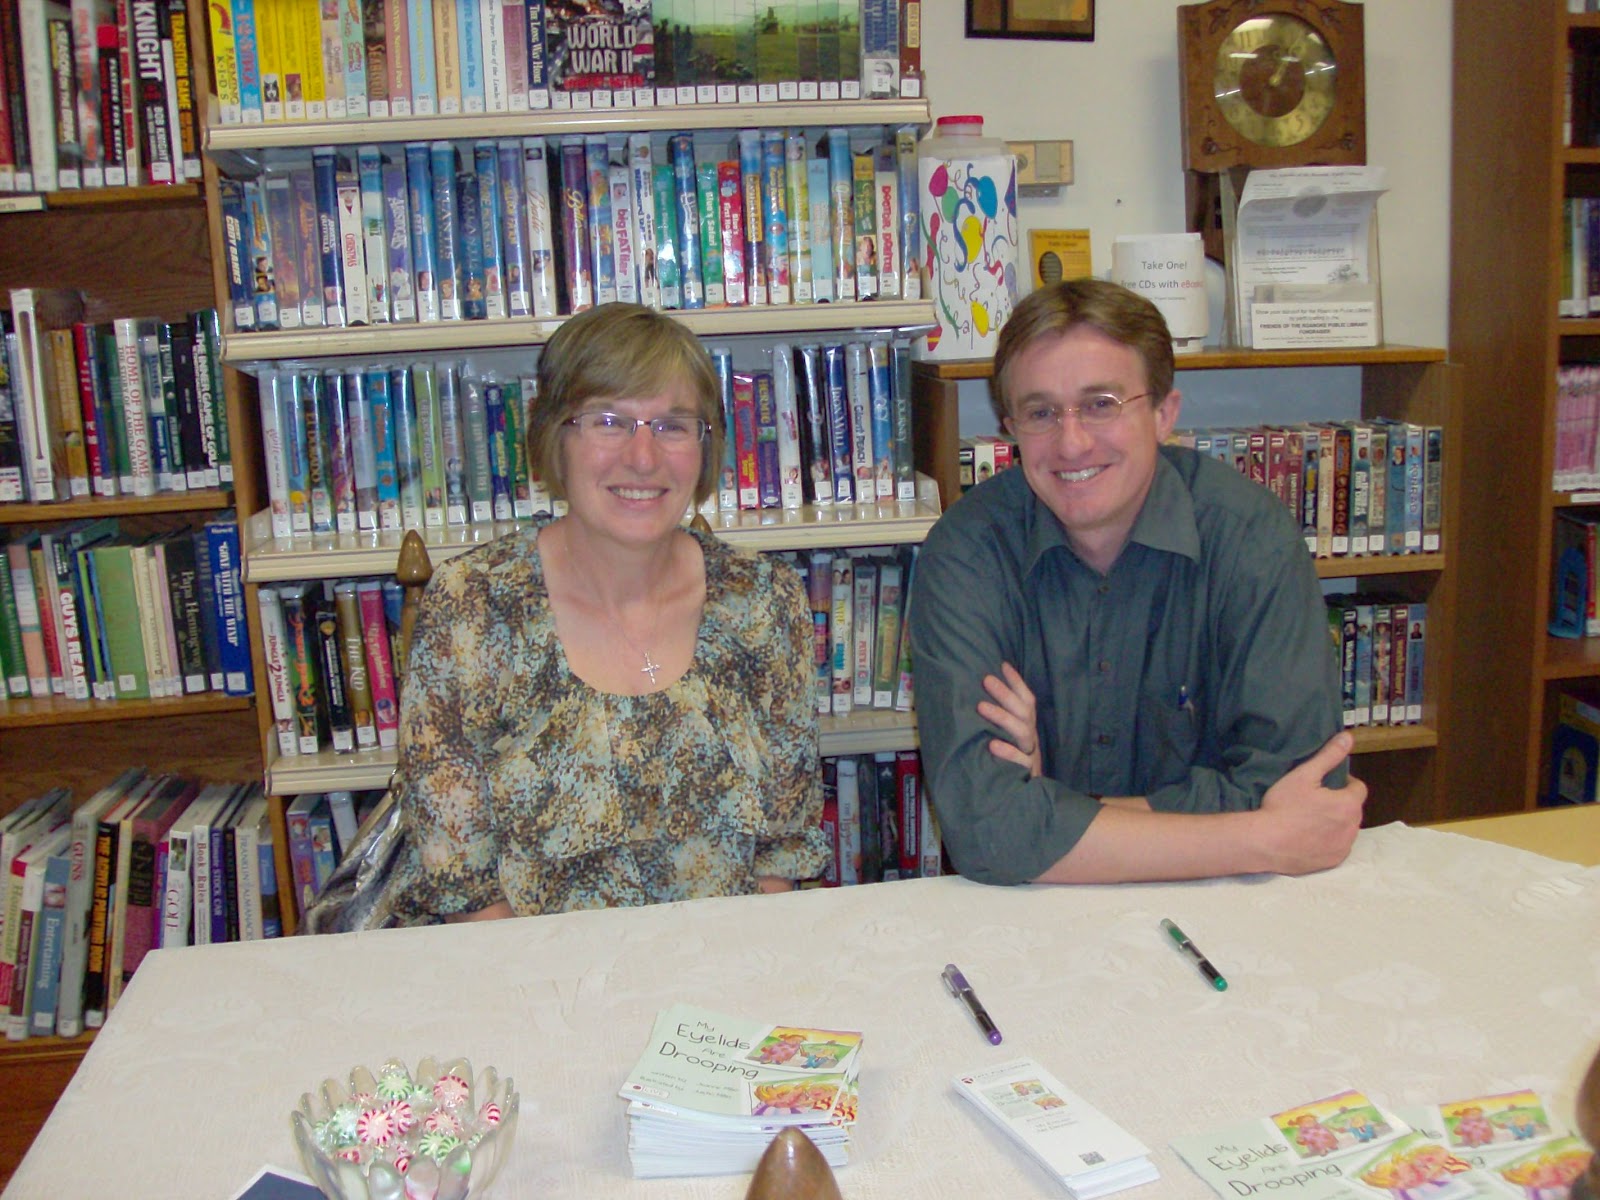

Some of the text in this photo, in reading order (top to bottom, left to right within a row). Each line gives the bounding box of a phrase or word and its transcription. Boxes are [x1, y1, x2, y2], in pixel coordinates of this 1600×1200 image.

[134, 2, 163, 82] KNIGHT
[170, 14, 189, 77] TRANSITION
[567, 24, 637, 49] WORLD
[109, 58, 118, 102] PLAYING
[572, 50, 618, 74] WAR
[177, 78, 191, 110] GAME
[112, 105, 120, 125] FOR
[154, 106, 169, 162] BOB KNIGHT
[388, 197, 407, 250] ARISTOCATS
[882, 185, 892, 230] DOCTOR
[226, 215, 241, 284] CODY BANKS
[345, 233, 357, 267] CHRISTMAS
[616, 208, 632, 276] big FAT liar
[707, 220, 717, 246] Safari
[1139, 280, 1156, 289] CDs
[1159, 280, 1179, 289] with
[1141, 261, 1188, 270] Take One!
[195, 331, 206, 354] THE
[198, 356, 210, 392] INNER
[125, 345, 149, 477] HOME OF THE GAME
[202, 393, 214, 425] GAME
[896, 399, 906, 443] JOURNEY
[206, 426, 215, 440] OF
[856, 436, 866, 463] PEACH
[424, 434, 434, 472] FRIDAY
[221, 571, 232, 594] WITH
[60, 592, 79, 637] GUYS
[180, 571, 202, 667] Papa Hemingway
[225, 597, 234, 616] THE
[68, 641, 87, 689] READ
[268, 635, 285, 702] JUNGLE 2 JUNGLE
[347, 636, 365, 691] THE KID
[72, 842, 84, 881] GUNS
[97, 837, 110, 856] THE
[94, 855, 109, 899] ACRYLIC
[197, 842, 207, 904] Book Rules
[212, 832, 222, 916] Ultimate STOCK CAR
[5, 884, 24, 960] Homemade
[92, 899, 106, 945] PAINTING
[37, 917, 59, 989] Entertaining
[676, 1023, 750, 1049] Eyelids
[696, 1021, 715, 1032] My
[659, 1041, 759, 1080] Drooping
[702, 1048, 726, 1058] Are
[1207, 1143, 1289, 1171] Eyelids
[1214, 1144, 1238, 1155] My
[1227, 1163, 1343, 1197] Drooping
